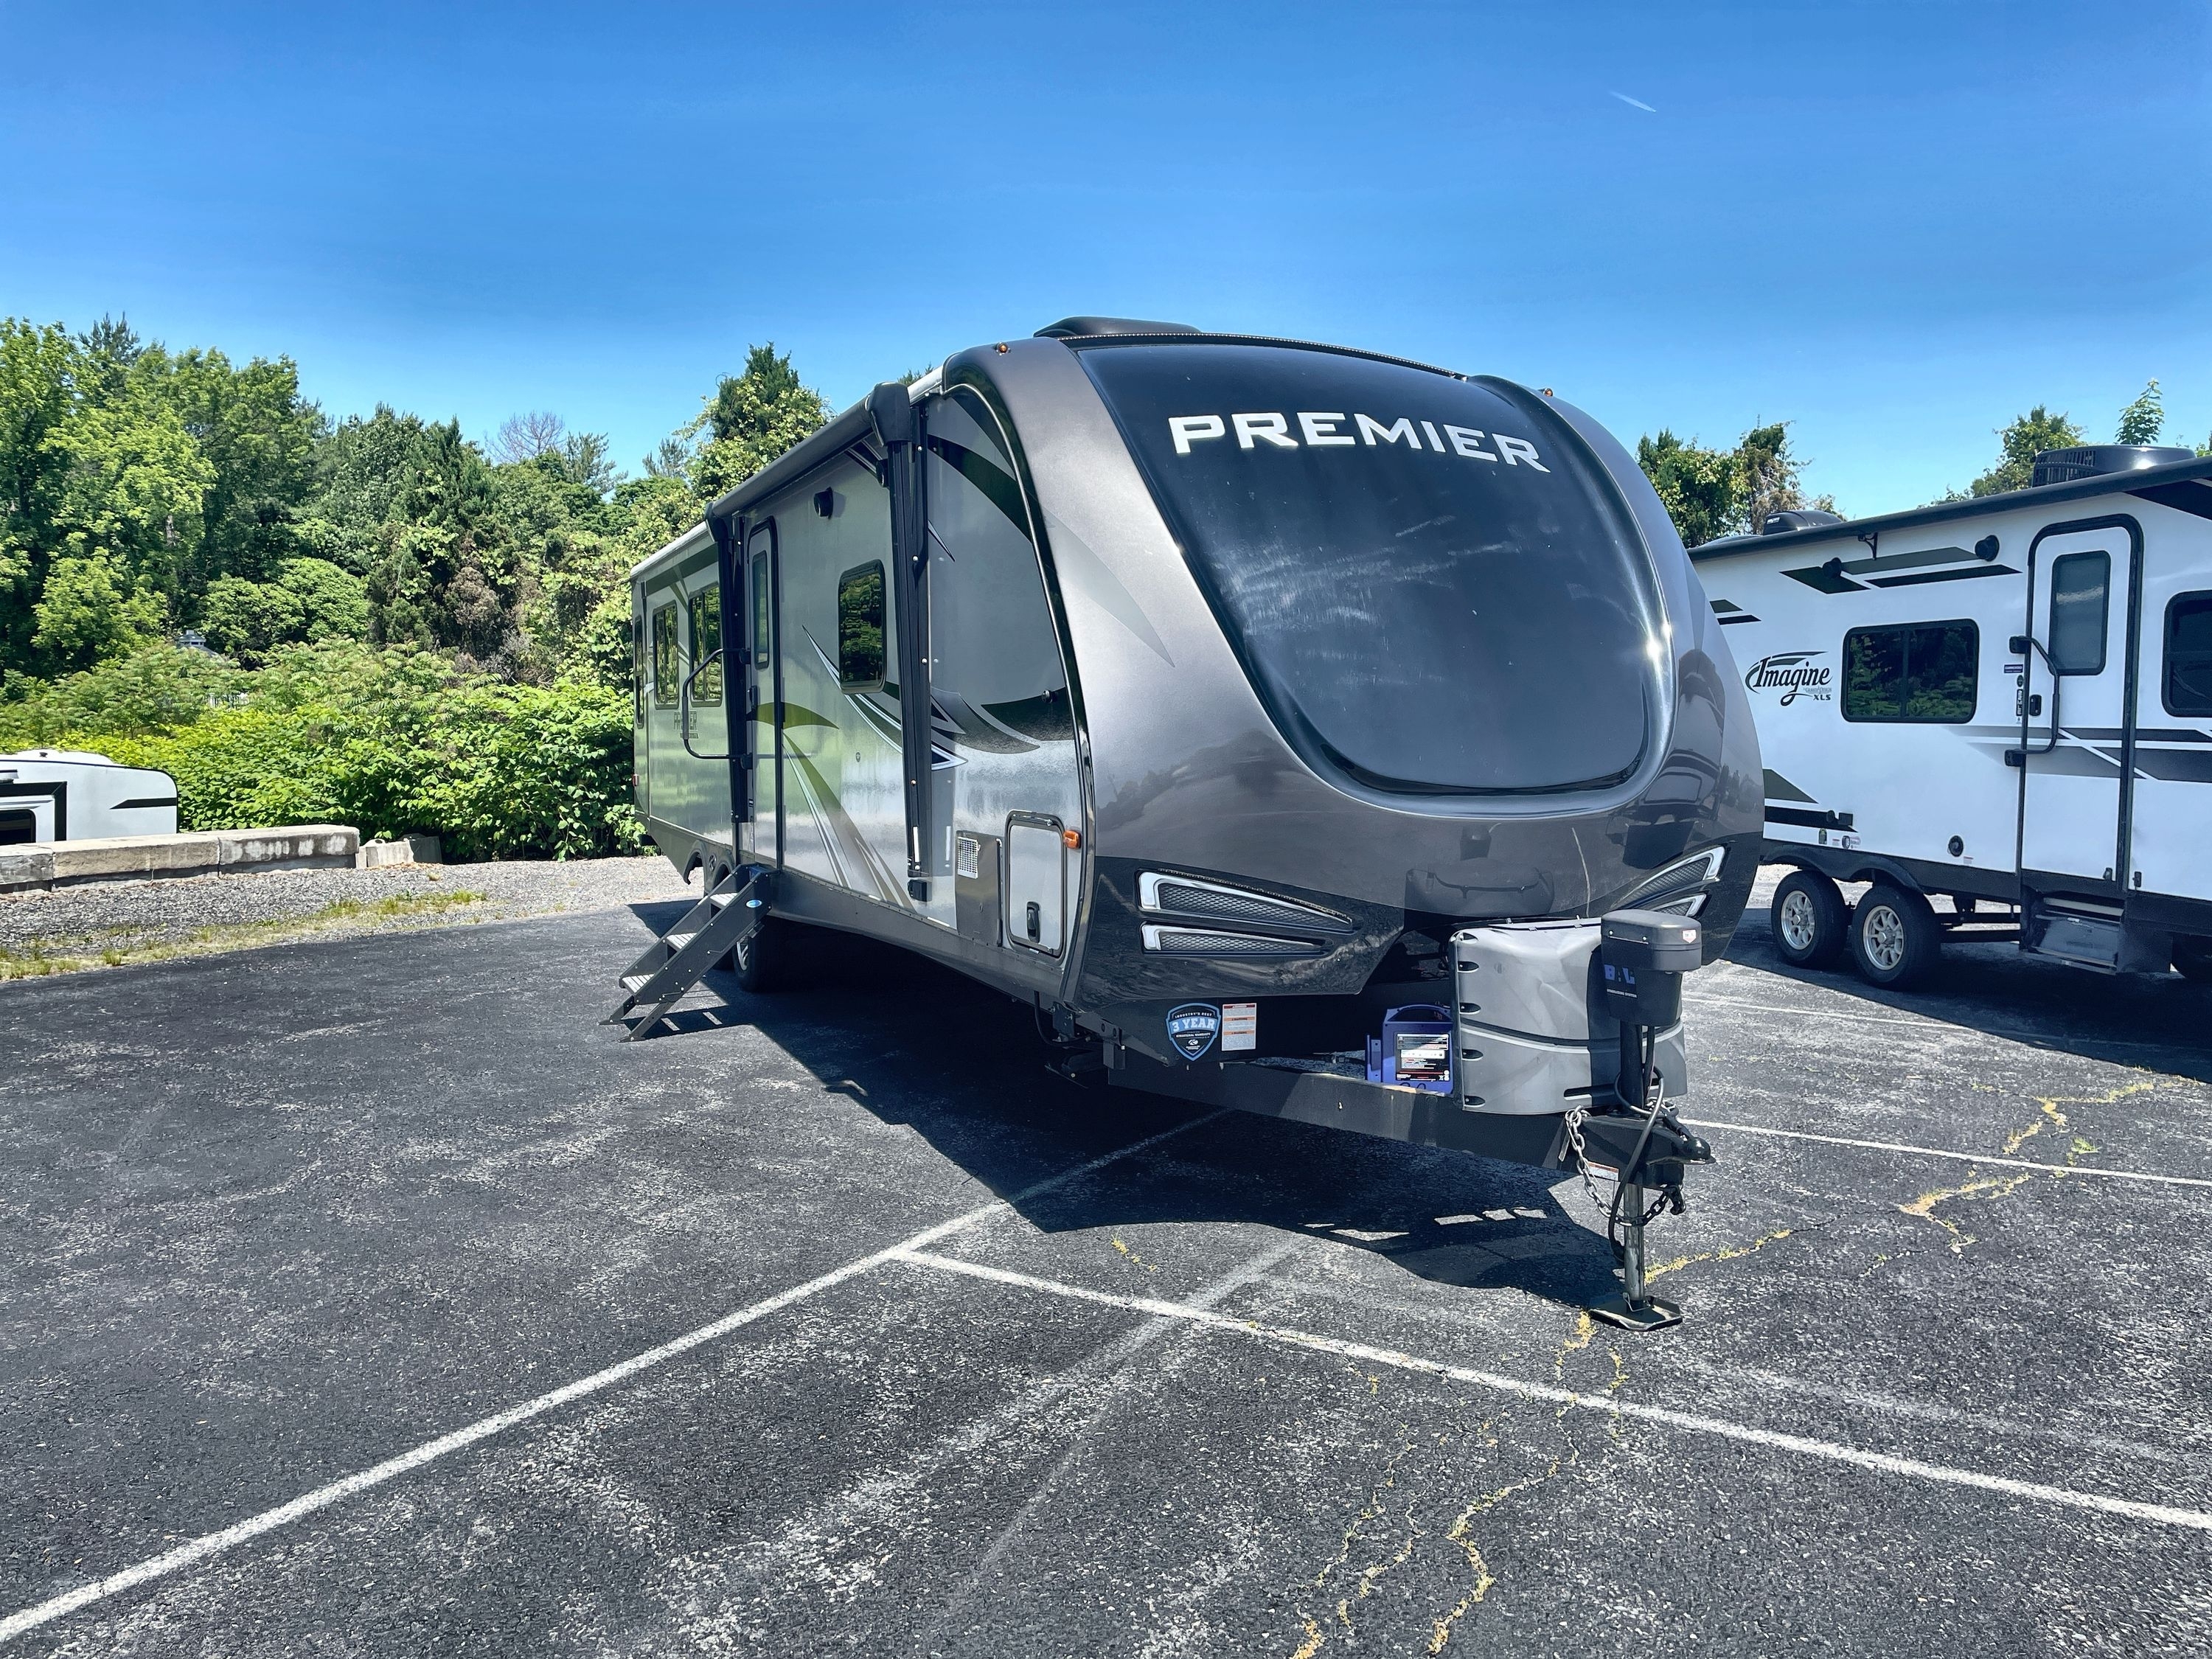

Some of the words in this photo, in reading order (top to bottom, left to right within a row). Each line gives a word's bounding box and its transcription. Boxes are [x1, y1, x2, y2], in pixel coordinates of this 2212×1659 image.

[1168, 411, 1551, 473] PREMIER
[1753, 656, 1833, 706] Imagine
[1172, 1021, 1180, 1032] 3
[1182, 1018, 1215, 1029] YEAR
